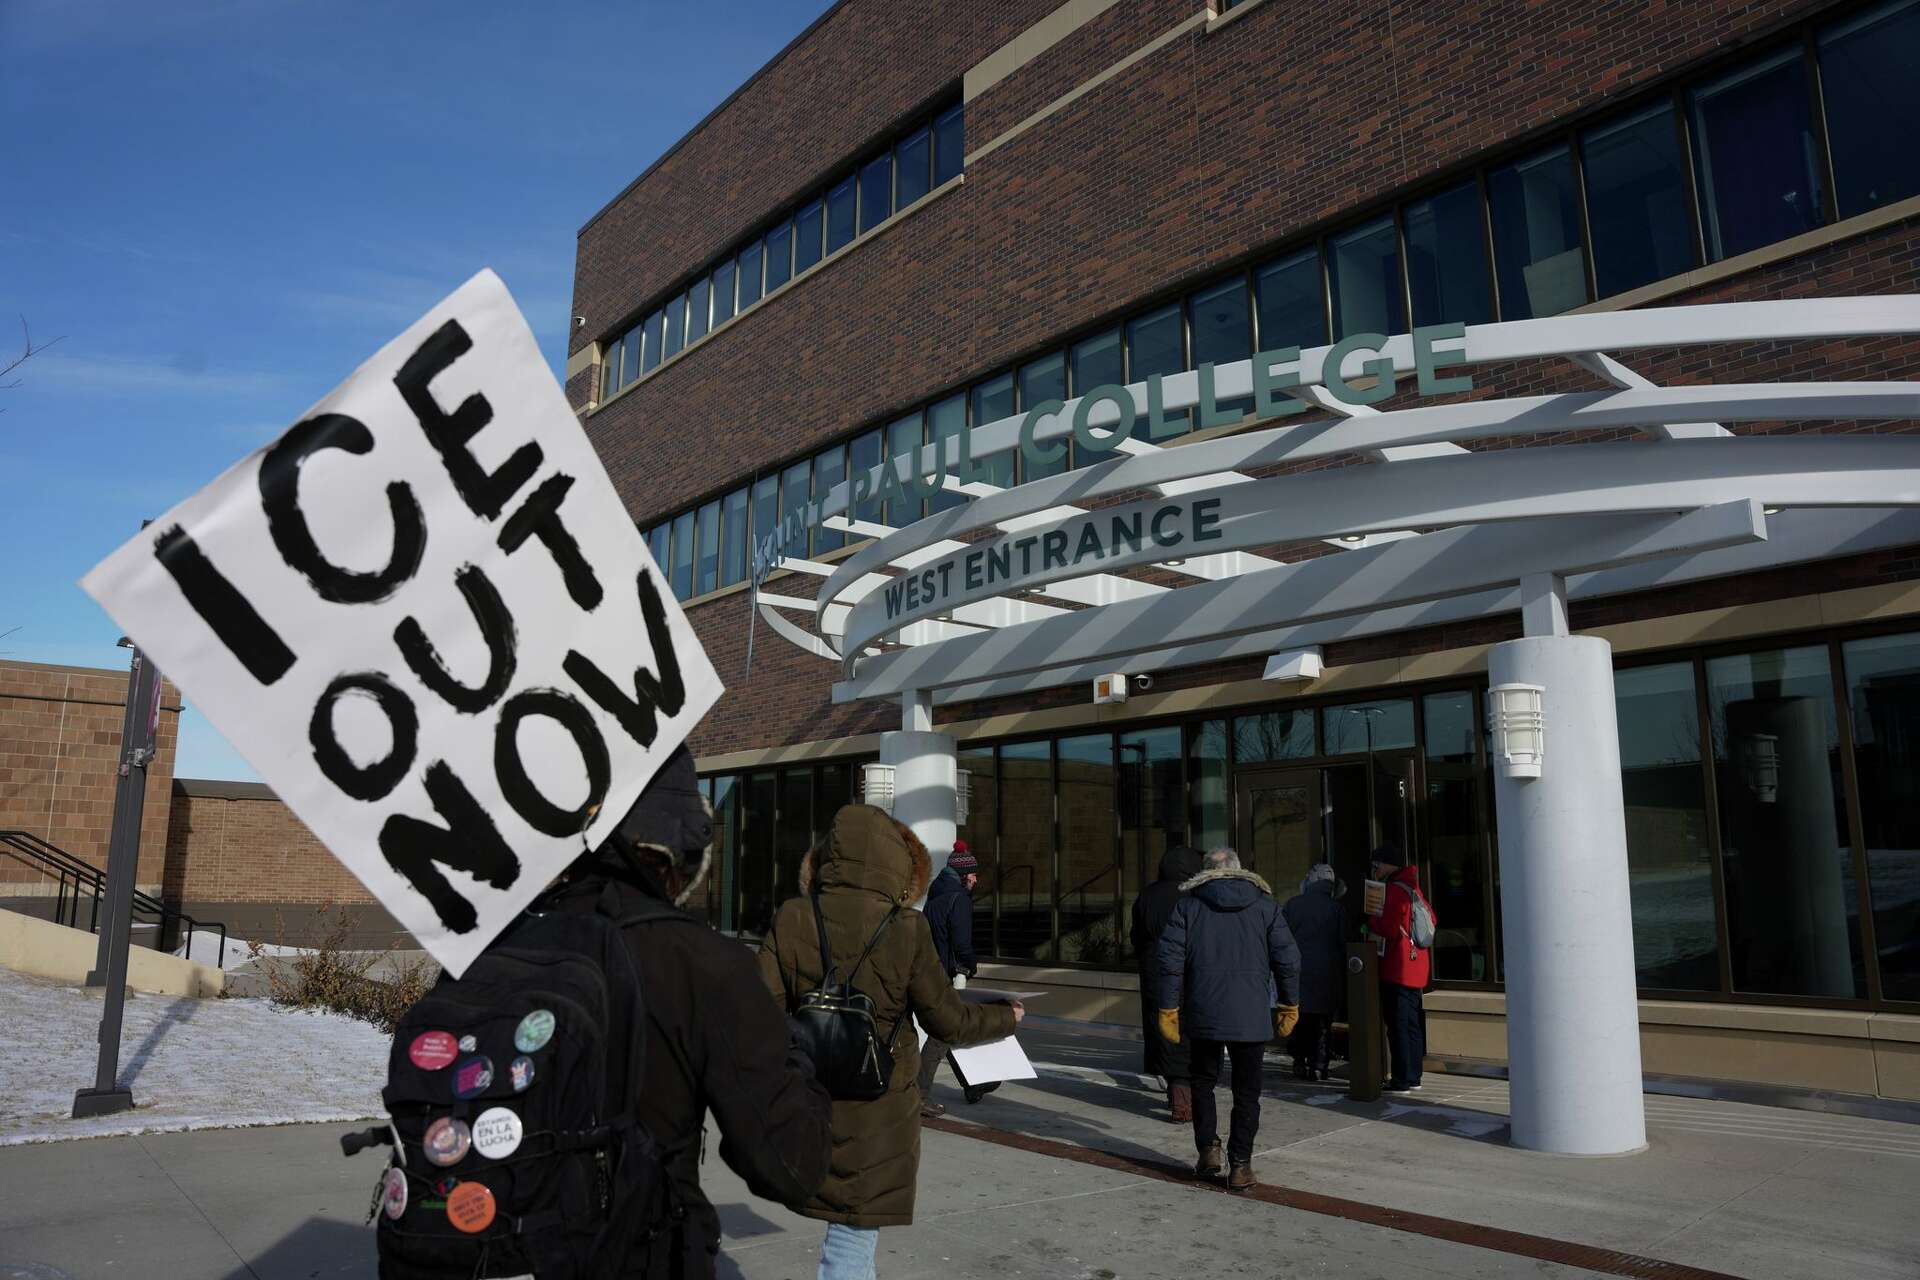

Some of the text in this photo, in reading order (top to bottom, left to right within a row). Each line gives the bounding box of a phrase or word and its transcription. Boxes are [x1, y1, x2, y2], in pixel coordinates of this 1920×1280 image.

[154, 318, 545, 686] ICE
[847, 426, 988, 528] PAUL
[1018, 321, 1474, 466] COLLEGE
[308, 471, 604, 802] OUT
[884, 497, 1223, 620] WEST ENTRANCE
[377, 567, 687, 935] NOW
[479, 1123, 512, 1138] EN LA
[480, 1133, 515, 1148] LUCHA
